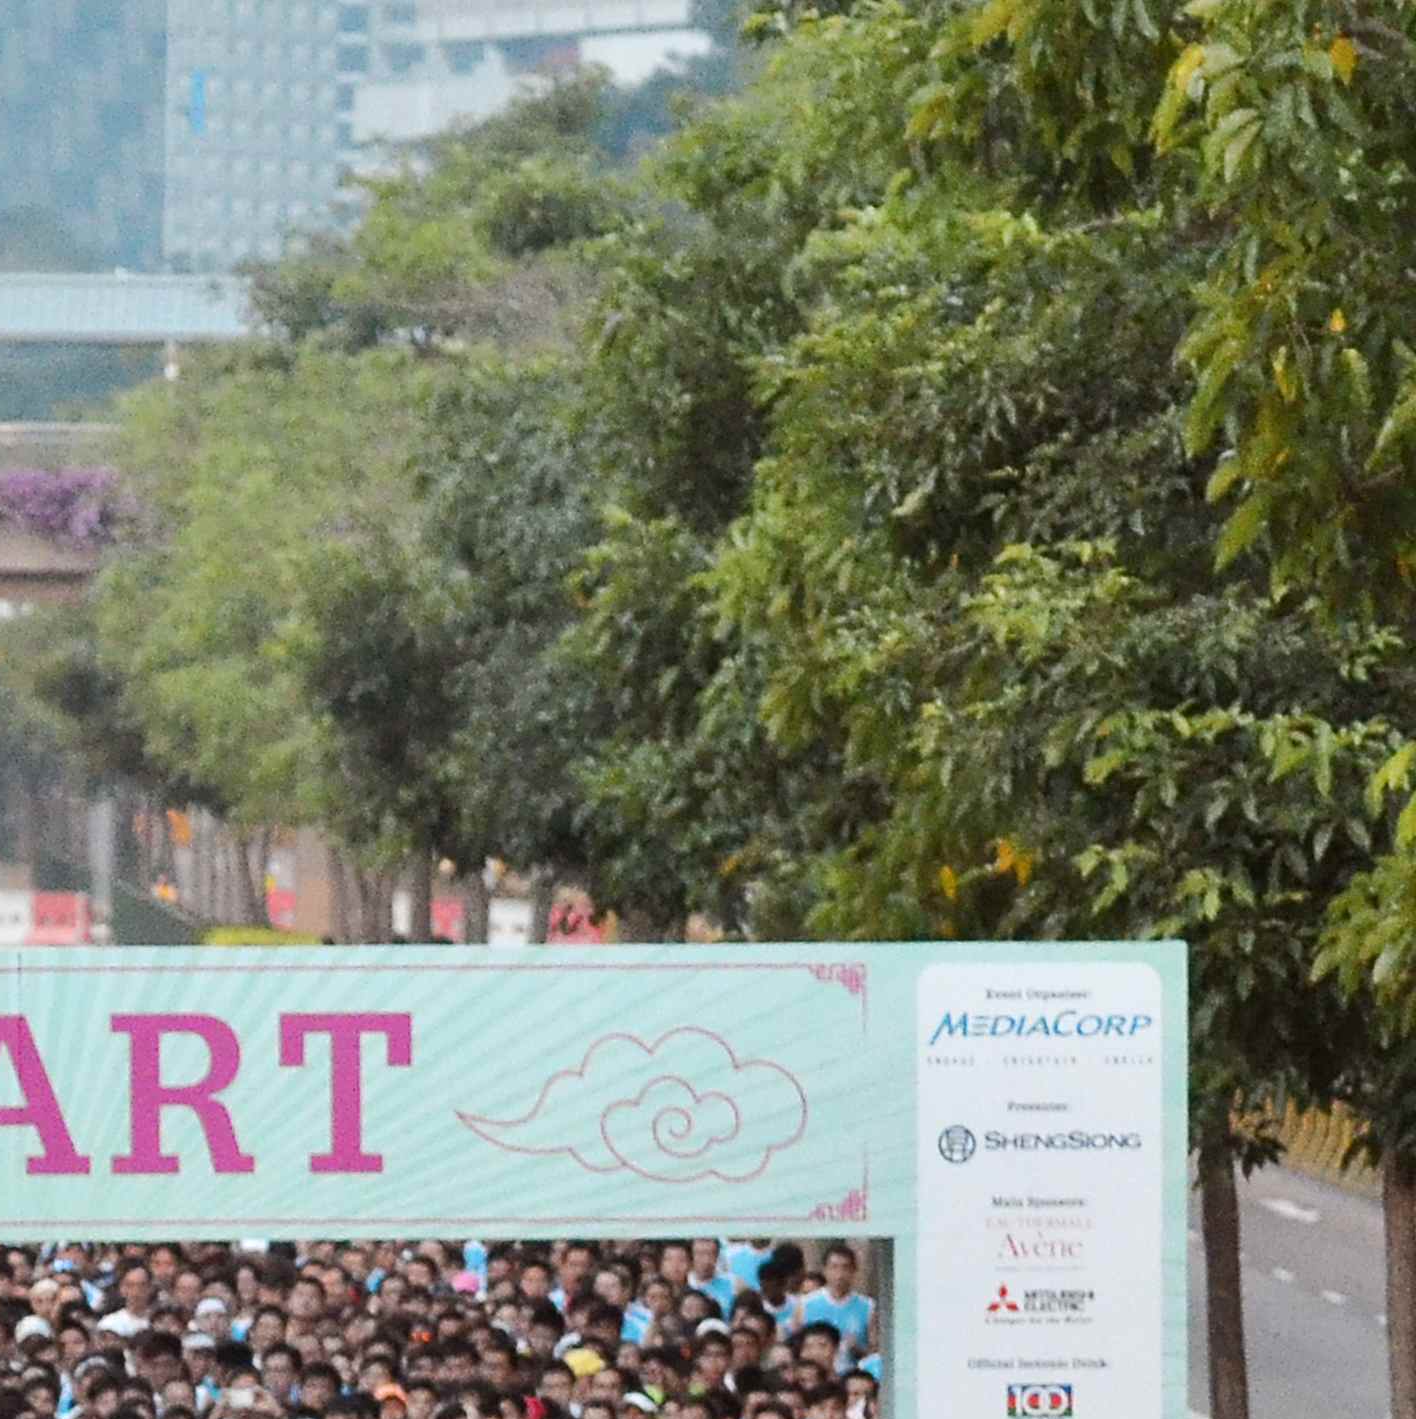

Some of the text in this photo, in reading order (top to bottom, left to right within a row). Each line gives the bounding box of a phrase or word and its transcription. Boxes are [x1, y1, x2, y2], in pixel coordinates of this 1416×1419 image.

[929, 1010, 1153, 1046] MEDIACORP
[1023, 1301, 1086, 1312] ELECTRIC
[1009, 1384, 1072, 1417] 100
